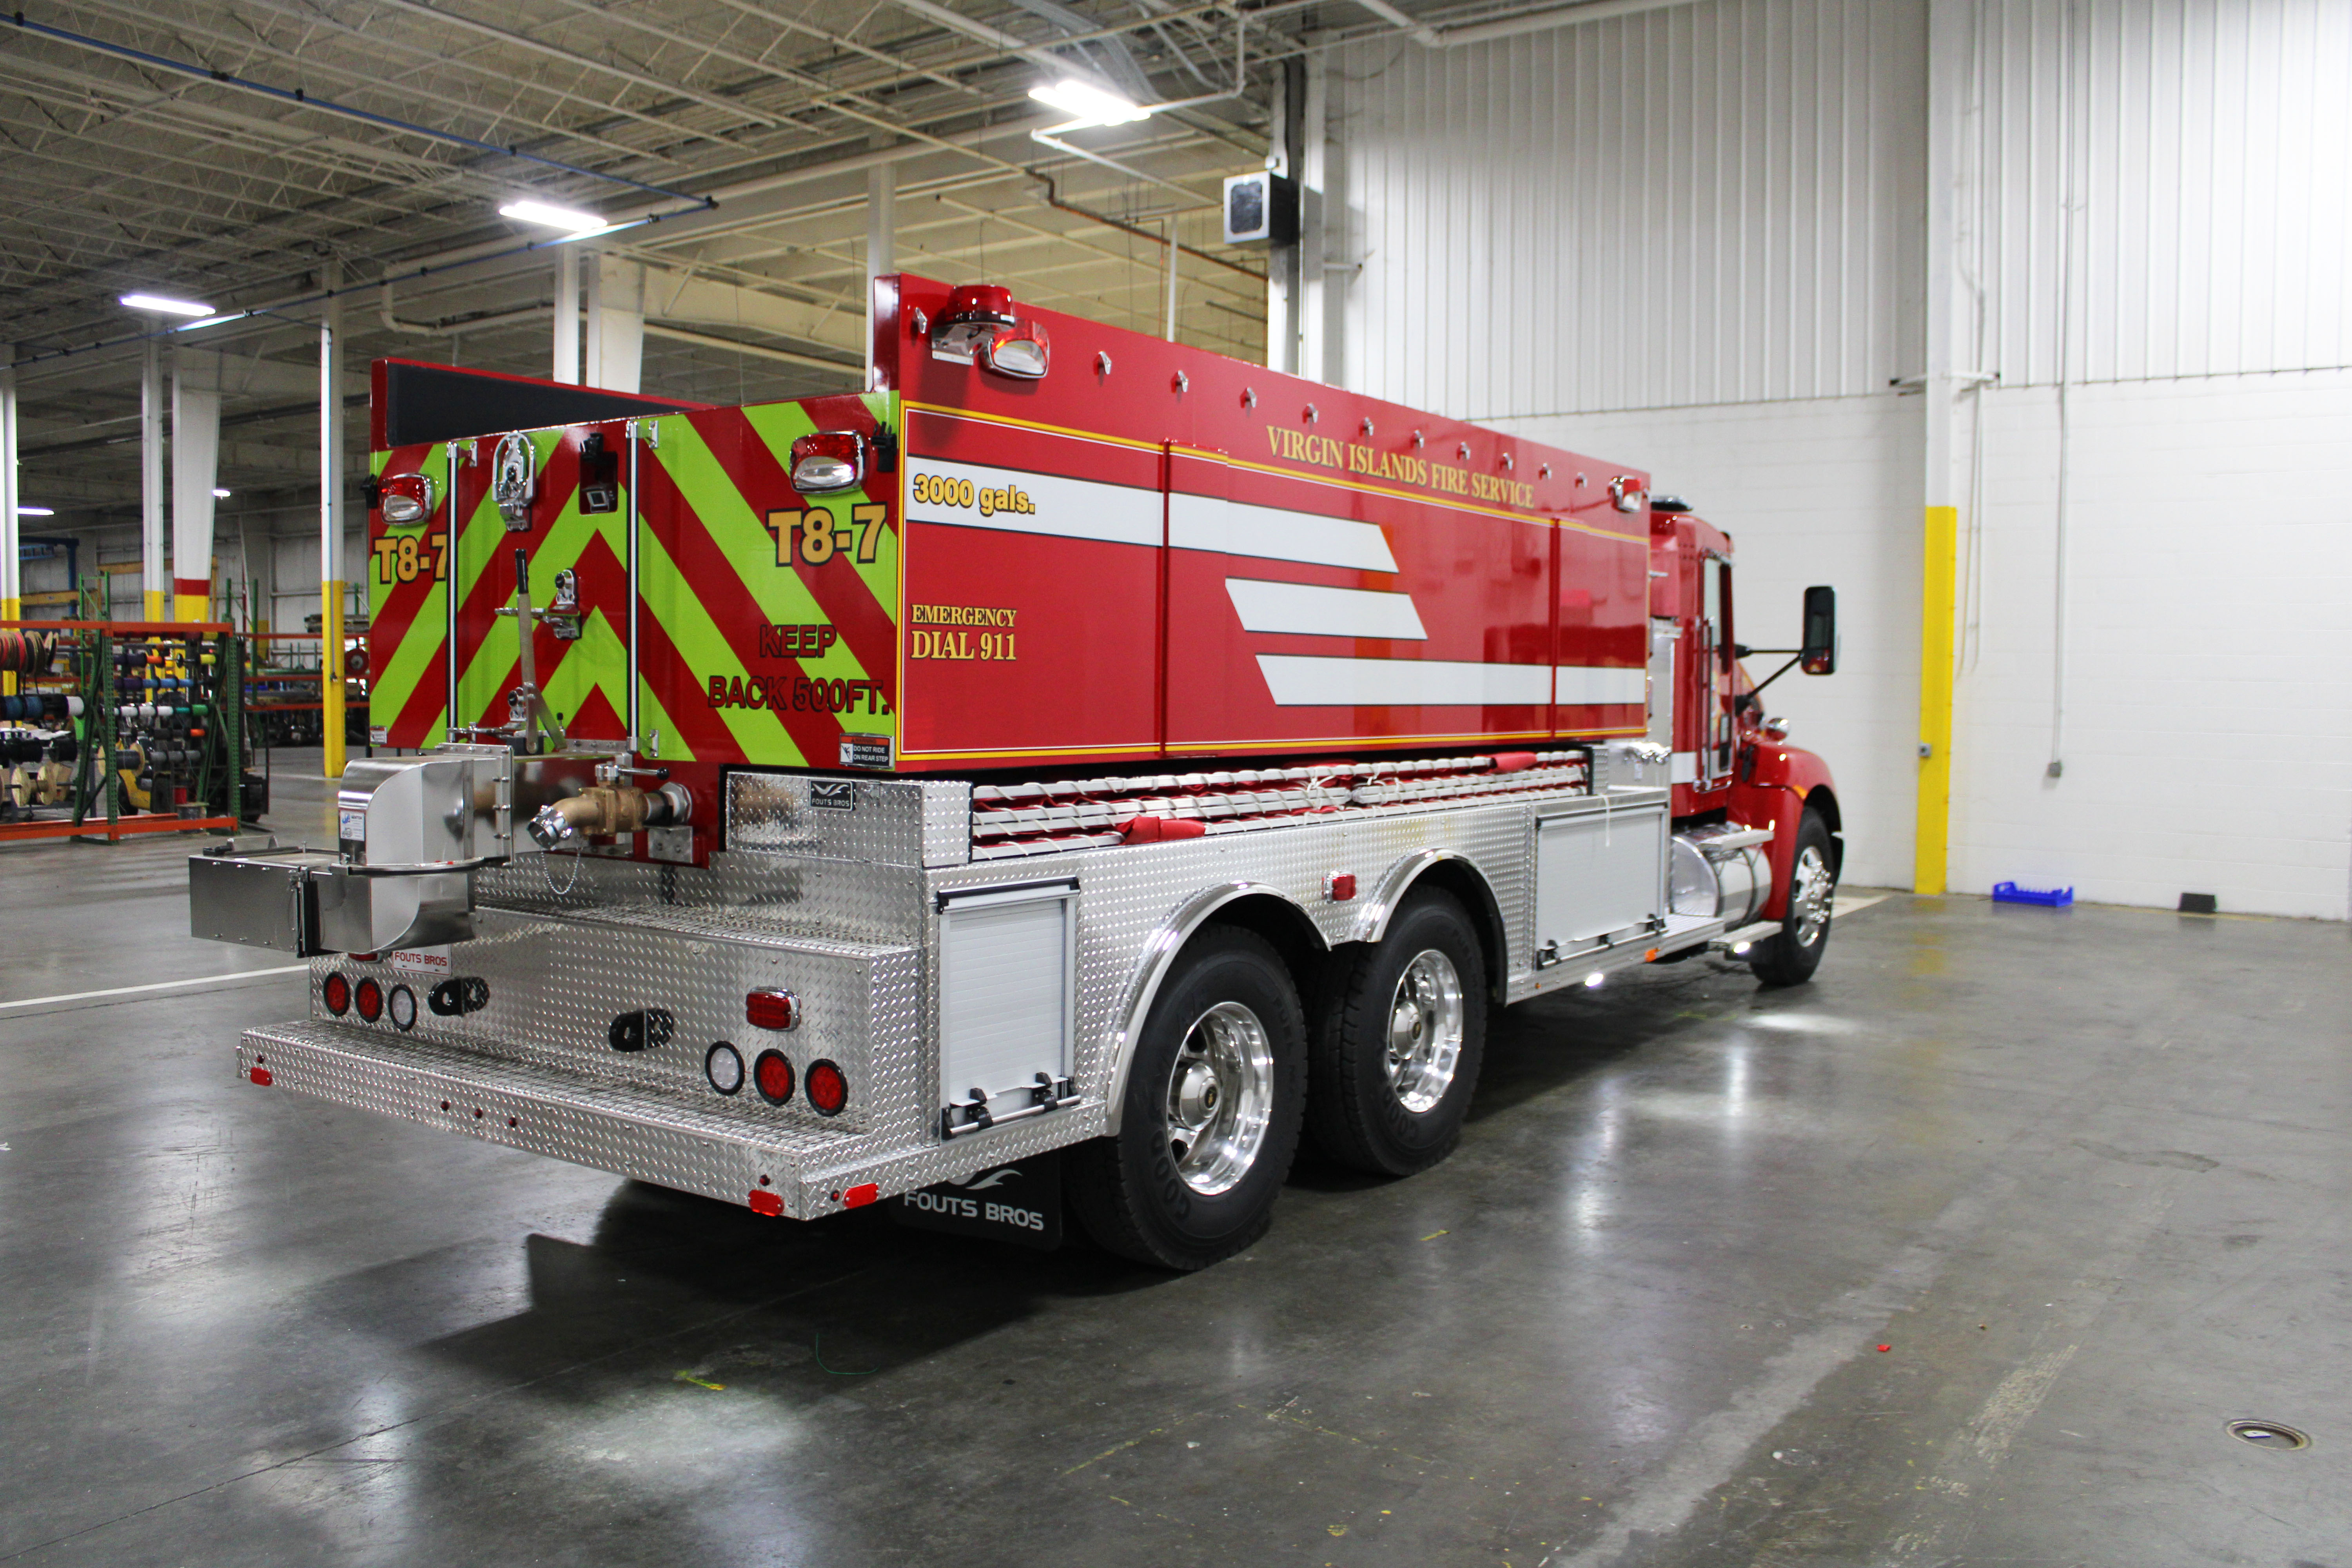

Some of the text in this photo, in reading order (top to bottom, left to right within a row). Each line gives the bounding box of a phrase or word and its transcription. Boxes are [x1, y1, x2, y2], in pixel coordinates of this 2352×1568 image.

[1266, 425, 1534, 509] VIRGIN ISLANDS FIRE SERVICE
[913, 473, 1035, 516] 3000 gals.
[766, 502, 887, 567] T8-7
[372, 533, 446, 584] T8-7
[911, 604, 1016, 627] EMERGENCY
[760, 624, 836, 658] KEEP
[911, 630, 1016, 661] DIAL 911
[708, 676, 889, 715] BACK 500FT.
[395, 952, 447, 966] FOUTS BROS
[904, 1191, 1045, 1231] FOUTS BROS
